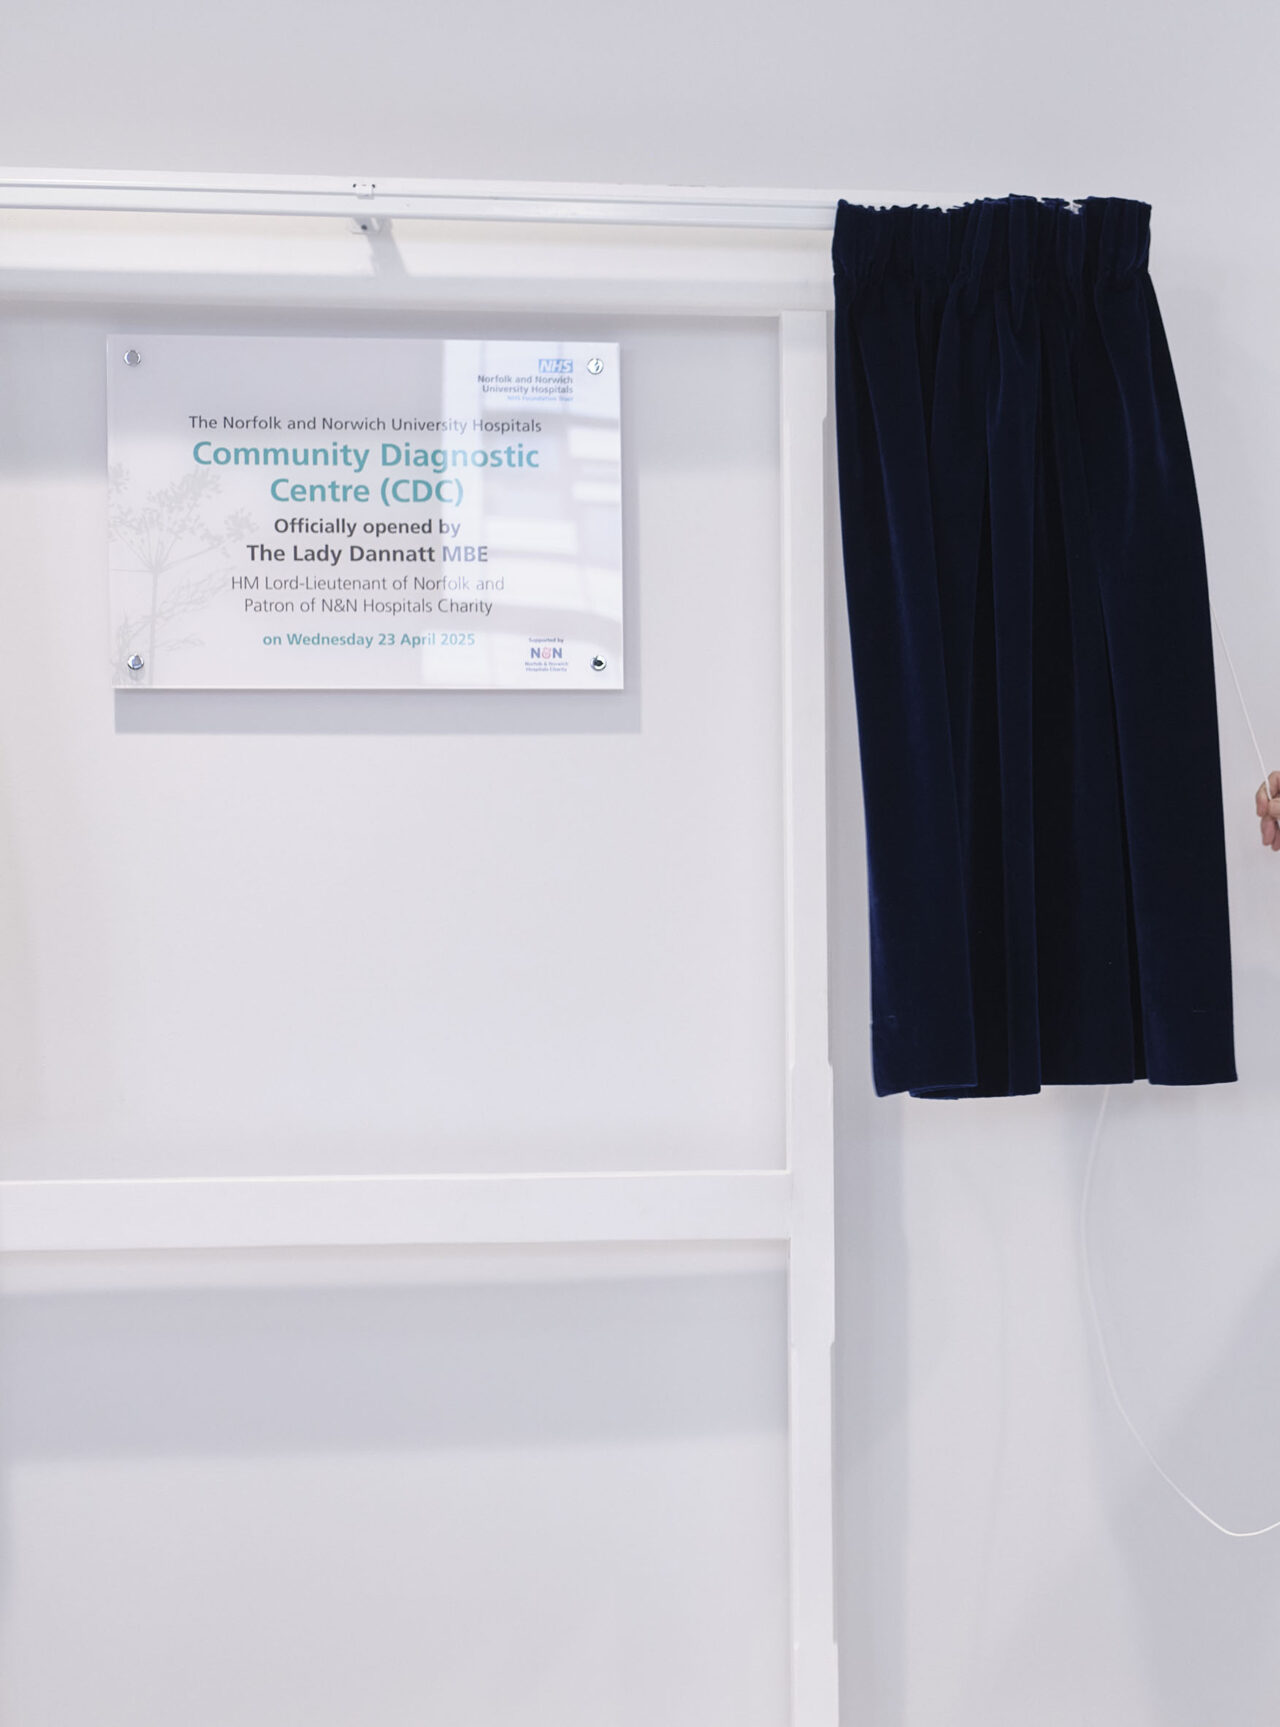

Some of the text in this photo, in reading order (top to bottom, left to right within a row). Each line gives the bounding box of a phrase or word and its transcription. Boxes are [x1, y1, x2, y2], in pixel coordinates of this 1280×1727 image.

[540, 360, 573, 373] NHS
[477, 375, 573, 384] Norfolk and Norwich
[482, 384, 573, 395] University Hospitals
[189, 415, 542, 436] The Norfolk and Norwich University Hospitals
[193, 441, 540, 474] Community Diagnostic
[270, 477, 464, 508] Centre (CDC)
[274, 517, 461, 538] Officially opened by
[246, 544, 489, 567] The Lady Dannatt MBE
[231, 575, 505, 591] HM Lord-Lieutenant of Norfolk and
[244, 597, 493, 617] Patron of N&N Hospitals Charity
[262, 632, 476, 649] on Wednesday 23 April 2025
